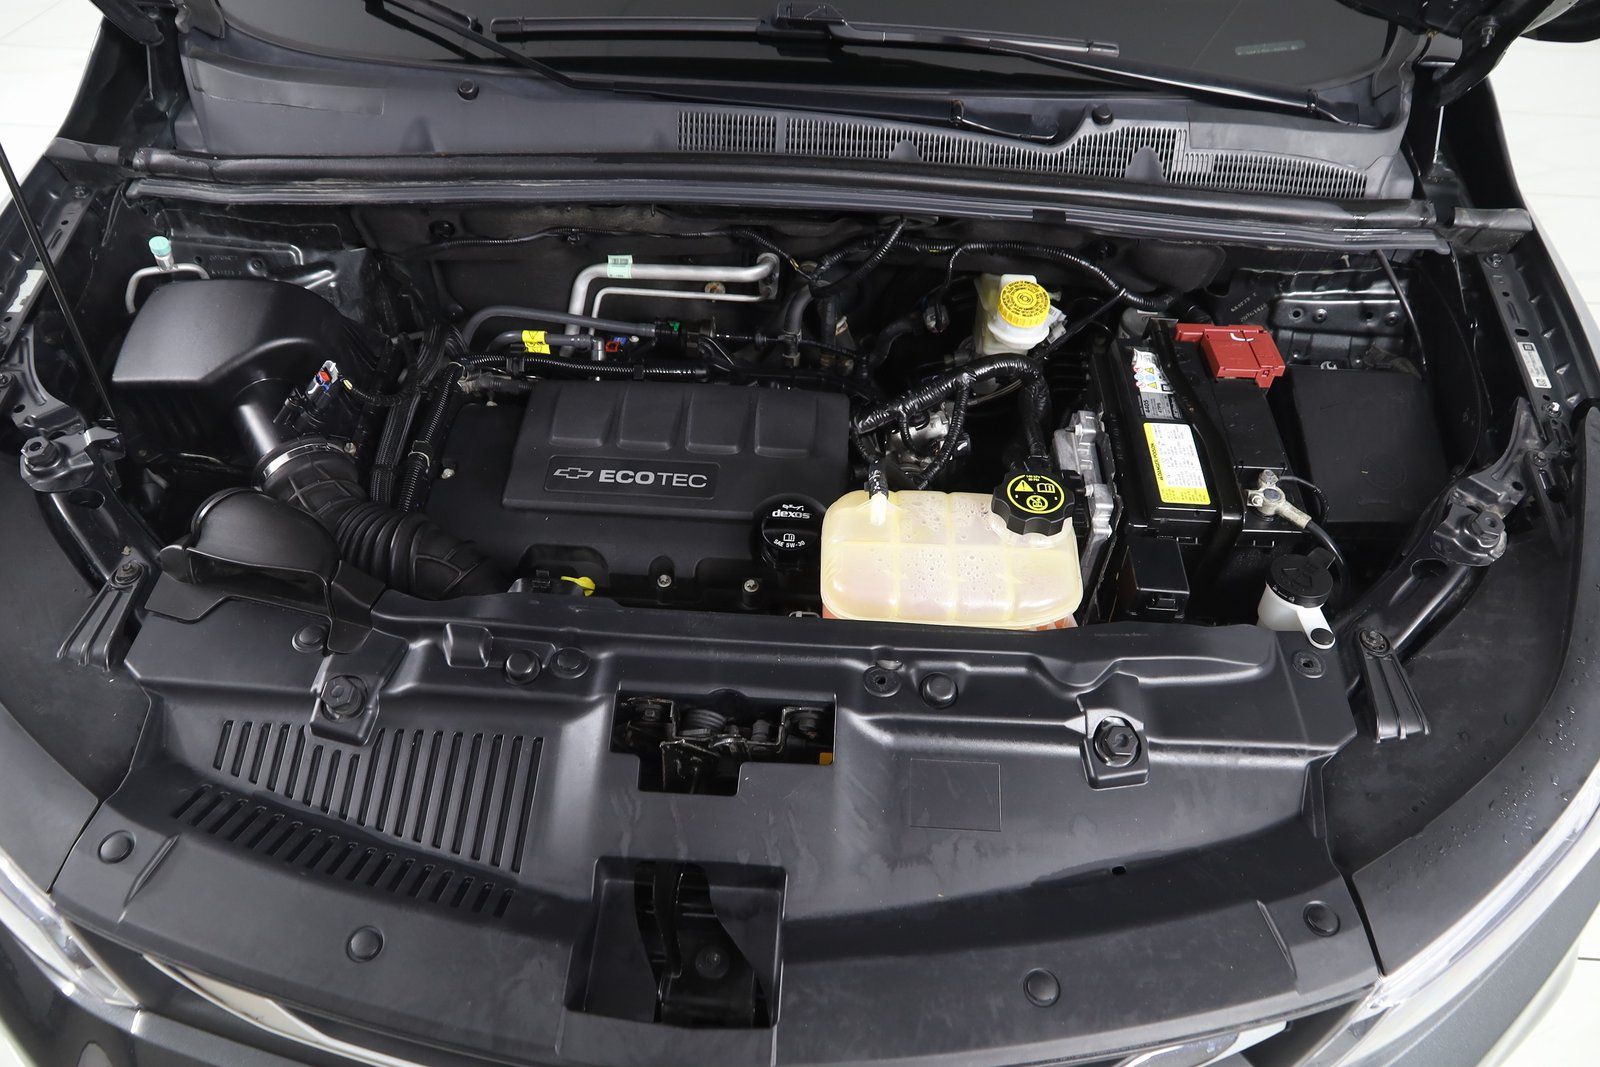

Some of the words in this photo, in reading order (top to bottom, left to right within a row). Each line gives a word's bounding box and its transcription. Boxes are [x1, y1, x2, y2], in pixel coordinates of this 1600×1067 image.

[599, 469, 708, 488] ECOTEC
[772, 509, 810, 519] dexos
[773, 539, 784, 547] SAE
